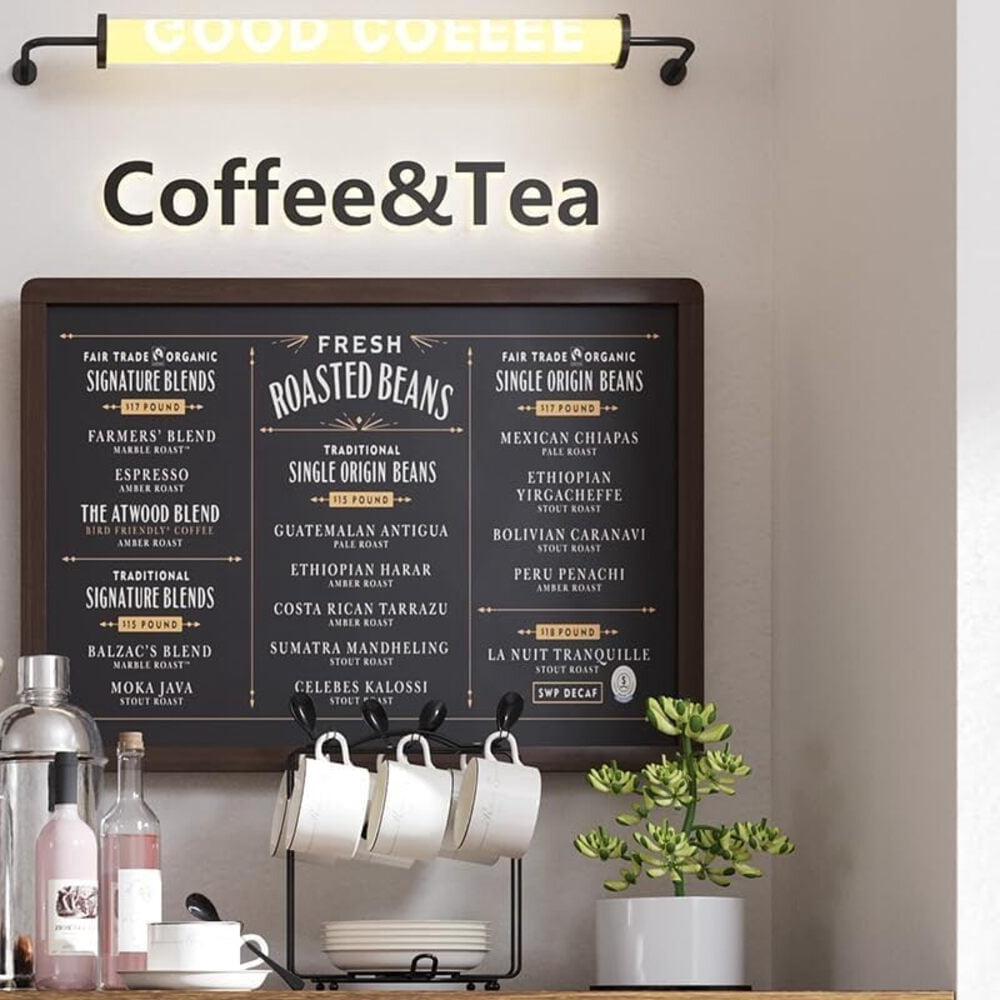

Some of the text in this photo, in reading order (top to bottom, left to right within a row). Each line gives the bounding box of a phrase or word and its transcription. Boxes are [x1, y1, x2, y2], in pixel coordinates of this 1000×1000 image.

[103, 156, 600, 227] Coffee&Tea
[318, 335, 401, 353] FRESH
[83, 351, 218, 362] FAIR TRADE ORGANIC
[502, 352, 636, 362] FAIR TRADE ORGANIC
[86, 369, 216, 392] SIGNATURE BLENDS
[496, 370, 643, 392] SINGLE ORIGIN BEANS
[269, 361, 453, 421] ROASTED BEANS
[144, 403, 180, 411] POUND
[558, 404, 595, 413] POUND
[167, 429, 216, 443] BLEND
[500, 431, 639, 445] MEXICAN CHIAPAS
[113, 446, 151, 454] MARBLE
[324, 445, 400, 456] TRADITIONAL
[542, 448, 597, 456] PALE ROAST
[115, 468, 189, 481] ESPRESSO
[288, 461, 437, 483] SINGLE ORIGIN BEANS
[528, 471, 612, 484] ETHIOPIAN
[119, 484, 184, 493] AMBER ROAST
[352, 495, 389, 505] POUND
[517, 489, 622, 502] YIRGACHEFFE
[80, 504, 220, 523] THE ATWOOD BLEND
[537, 505, 601, 513] STOUT ROAST
[86, 526, 110, 535] BIRD
[174, 526, 214, 535] COFFEE
[274, 524, 448, 538] GUATEMALAN ANTIGUA
[493, 528, 646, 541] BOLIVIAN CARANAVI
[118, 539, 183, 547] AMBER ROAST
[333, 540, 389, 549] PALE ROAST
[537, 544, 601, 552] STOUT ROAST
[291, 563, 431, 576] ETHIOPIAN HARAR
[514, 568, 625, 581] PERU PENACHI
[113, 570, 190, 581] TRADITIONAL
[328, 580, 394, 588] AMBER ROAST
[537, 584, 602, 592] AMBER ROAST
[86, 586, 215, 609] SIGNATURE BLENDS
[273, 602, 448, 616] COSTA RICAN TARRAZU
[141, 620, 178, 629] POUND
[328, 619, 394, 627] AMBER ROAST
[558, 628, 595, 637] POUND
[88, 645, 212, 658] BALZAC'S BLEND
[270, 641, 449, 655] SUMATRA MANDHELING
[329, 658, 394, 666] STOUT ROAST
[488, 648, 651, 666] LA NUIT TRANQUILLE
[113, 661, 151, 670] MARBLE
[536, 665, 599, 674] STOUT ROAST
[111, 681, 193, 697] MOKA JAVA
[294, 680, 428, 694] CELEBES KALOSSI
[538, 688, 598, 699] SWP DECAF
[329, 697, 360, 705] STOUT
